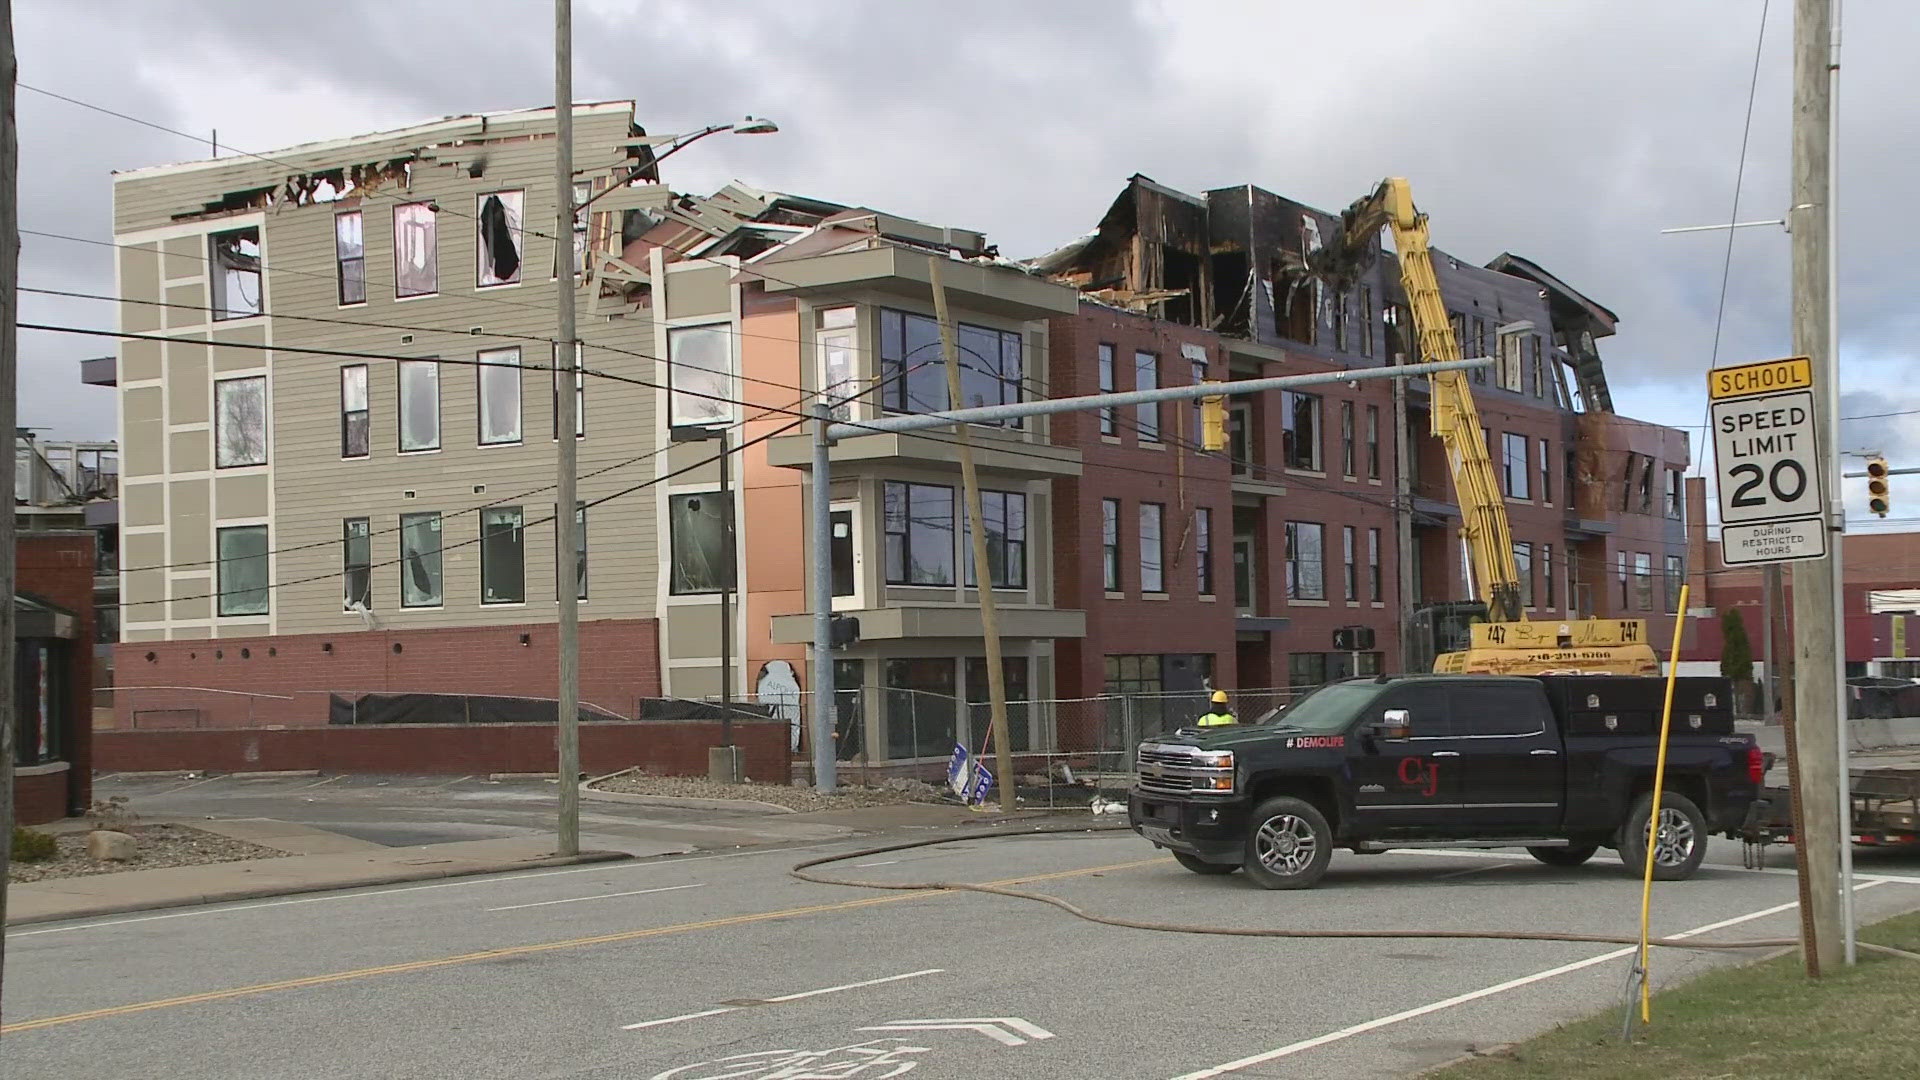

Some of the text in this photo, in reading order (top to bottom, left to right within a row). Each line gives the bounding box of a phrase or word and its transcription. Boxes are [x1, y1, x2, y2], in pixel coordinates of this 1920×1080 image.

[1721, 365, 1802, 393] SCHOOL
[1721, 407, 1806, 434] SPEED
[1732, 433, 1797, 458] LIMIT
[1728, 459, 1807, 508] 20
[1742, 535, 1804, 548] RESTRICTED
[1753, 527, 1791, 538] DURING
[1756, 546, 1791, 557] HOURS
[1620, 621, 1638, 641] 747
[1296, 736, 1344, 748] DEMOLIFE
